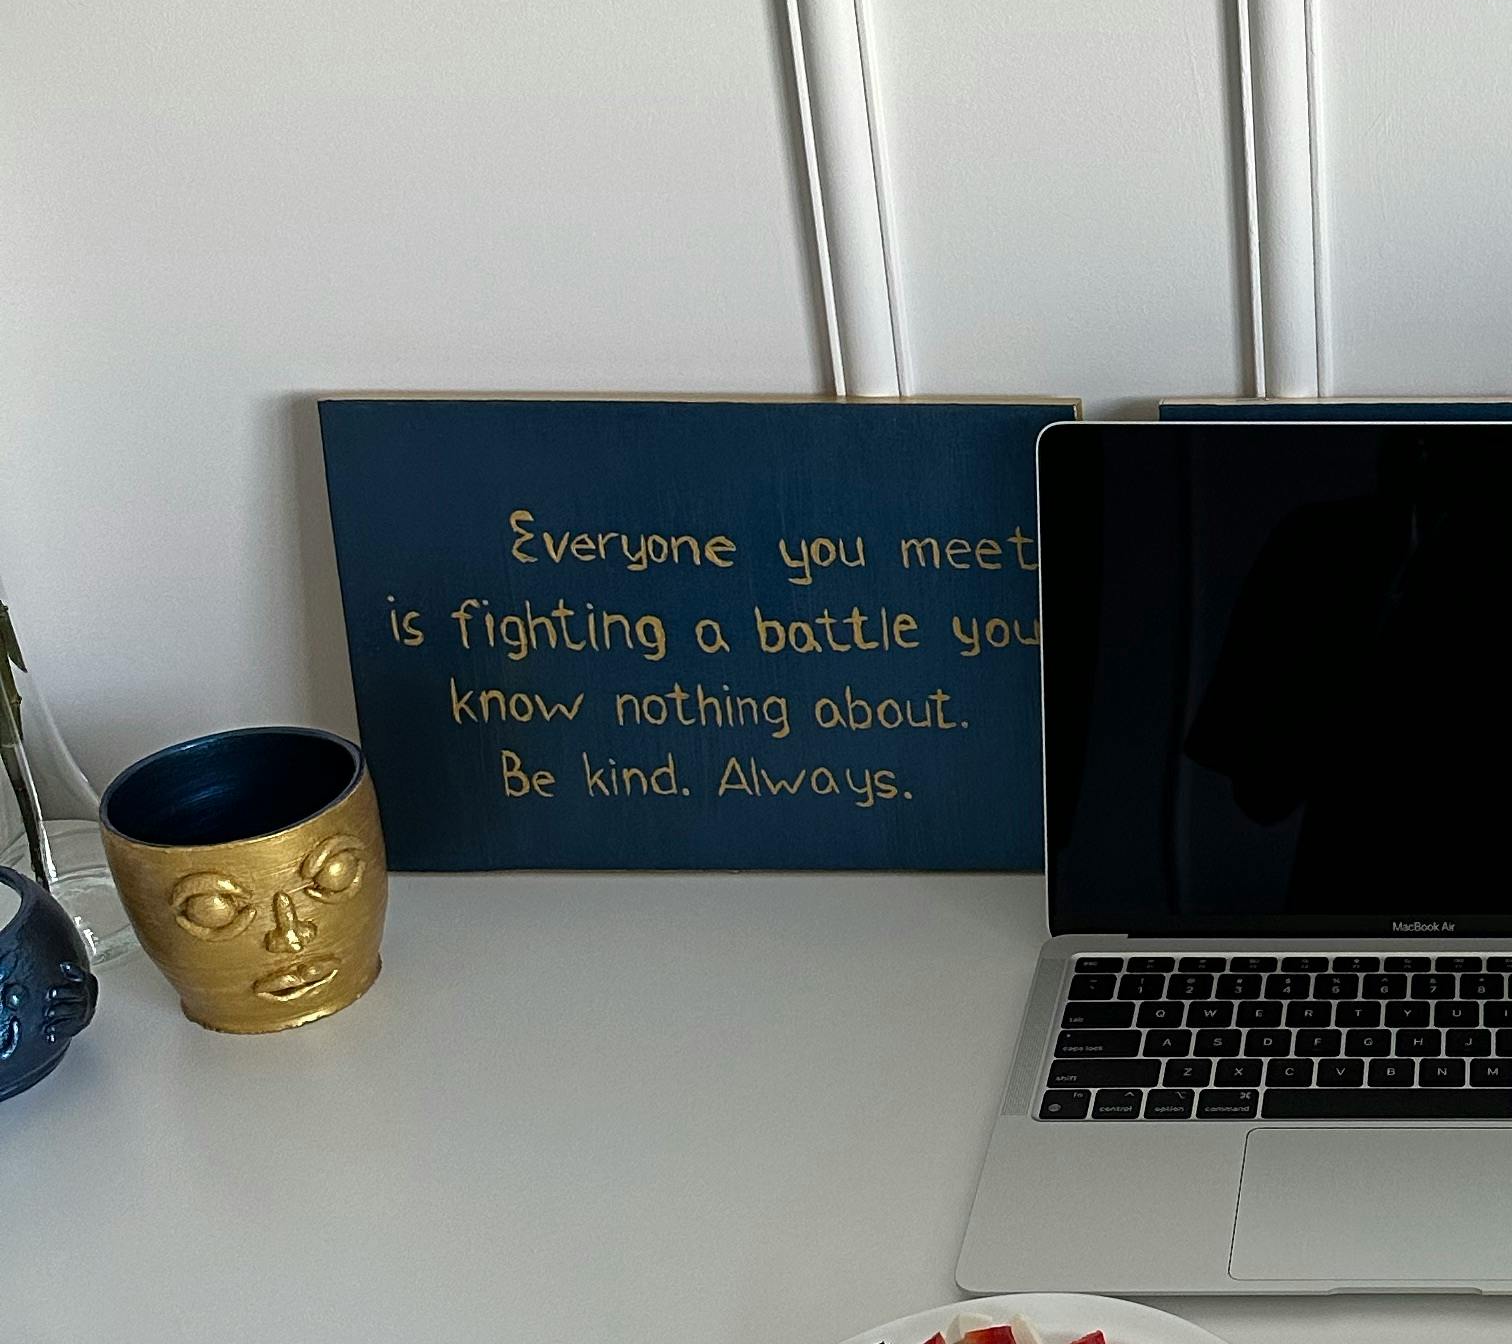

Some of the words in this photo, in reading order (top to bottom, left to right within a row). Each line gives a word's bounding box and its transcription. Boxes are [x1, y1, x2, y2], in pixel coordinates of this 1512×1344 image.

[509, 509, 735, 571] Everyone
[779, 537, 865, 586] you
[901, 528, 1039, 570] meet
[385, 594, 425, 647] is
[452, 598, 666, 661] fighting
[695, 619, 729, 653] a
[754, 607, 918, 653] battle
[450, 677, 584, 723] know
[616, 686, 790, 739] nothing
[814, 686, 971, 731] about.
[501, 750, 556, 797] Be
[582, 751, 693, 799] kind.
[719, 757, 912, 807] Always.
[1392, 921, 1440, 932] MacBook
[1441, 921, 1456, 932] Air
[1137, 986, 1143, 994] 1
[1185, 985, 1194, 994] 2
[1234, 985, 1243, 994] 3
[1282, 985, 1291, 994] 4
[1331, 985, 1340, 994] 5
[1380, 985, 1389, 994] 6
[1430, 985, 1437, 993] 7
[1477, 985, 1486, 994] 8
[1155, 1009, 1166, 1018] Q
[1203, 1009, 1217, 1017] W
[1255, 1009, 1264, 1018] E
[1304, 1009, 1313, 1017] R
[1354, 1009, 1362, 1017] T
[1403, 1009, 1412, 1017] Y
[1452, 1009, 1462, 1018] U
[1504, 1009, 1508, 1017] I
[1162, 1038, 1172, 1047] A
[1212, 1037, 1223, 1047] S
[1263, 1037, 1273, 1046] D
[1314, 1037, 1322, 1046] F
[1363, 1037, 1374, 1046] G
[1413, 1038, 1424, 1046] H
[1464, 1037, 1473, 1046] J
[1183, 1067, 1193, 1077] Z
[1234, 1067, 1244, 1076] X
[1284, 1067, 1294, 1076] C
[1335, 1067, 1346, 1076] V
[1386, 1067, 1396, 1076] B
[1437, 1067, 1448, 1076] N
[1487, 1067, 1499, 1076] M
